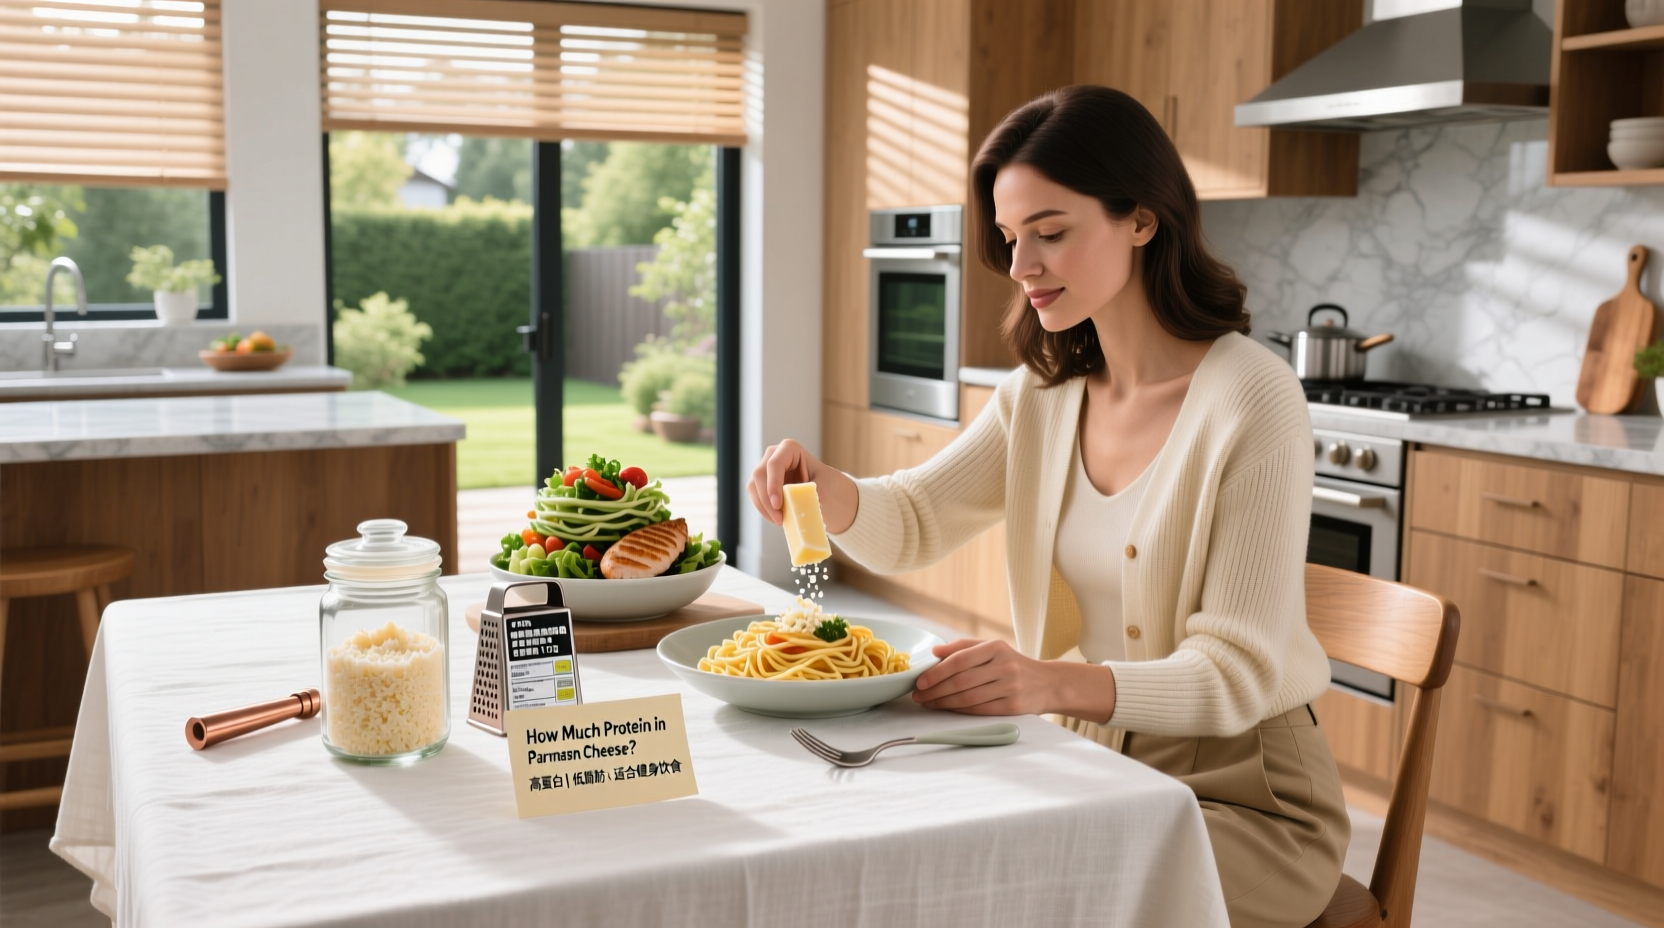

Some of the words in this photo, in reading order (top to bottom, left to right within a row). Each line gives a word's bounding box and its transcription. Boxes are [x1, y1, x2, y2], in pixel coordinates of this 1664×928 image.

[526, 728, 558, 745] How
[562, 723, 600, 741] Much
[604, 718, 652, 736] Protein
[654, 716, 666, 731] in
[583, 740, 637, 759] Cheese?
